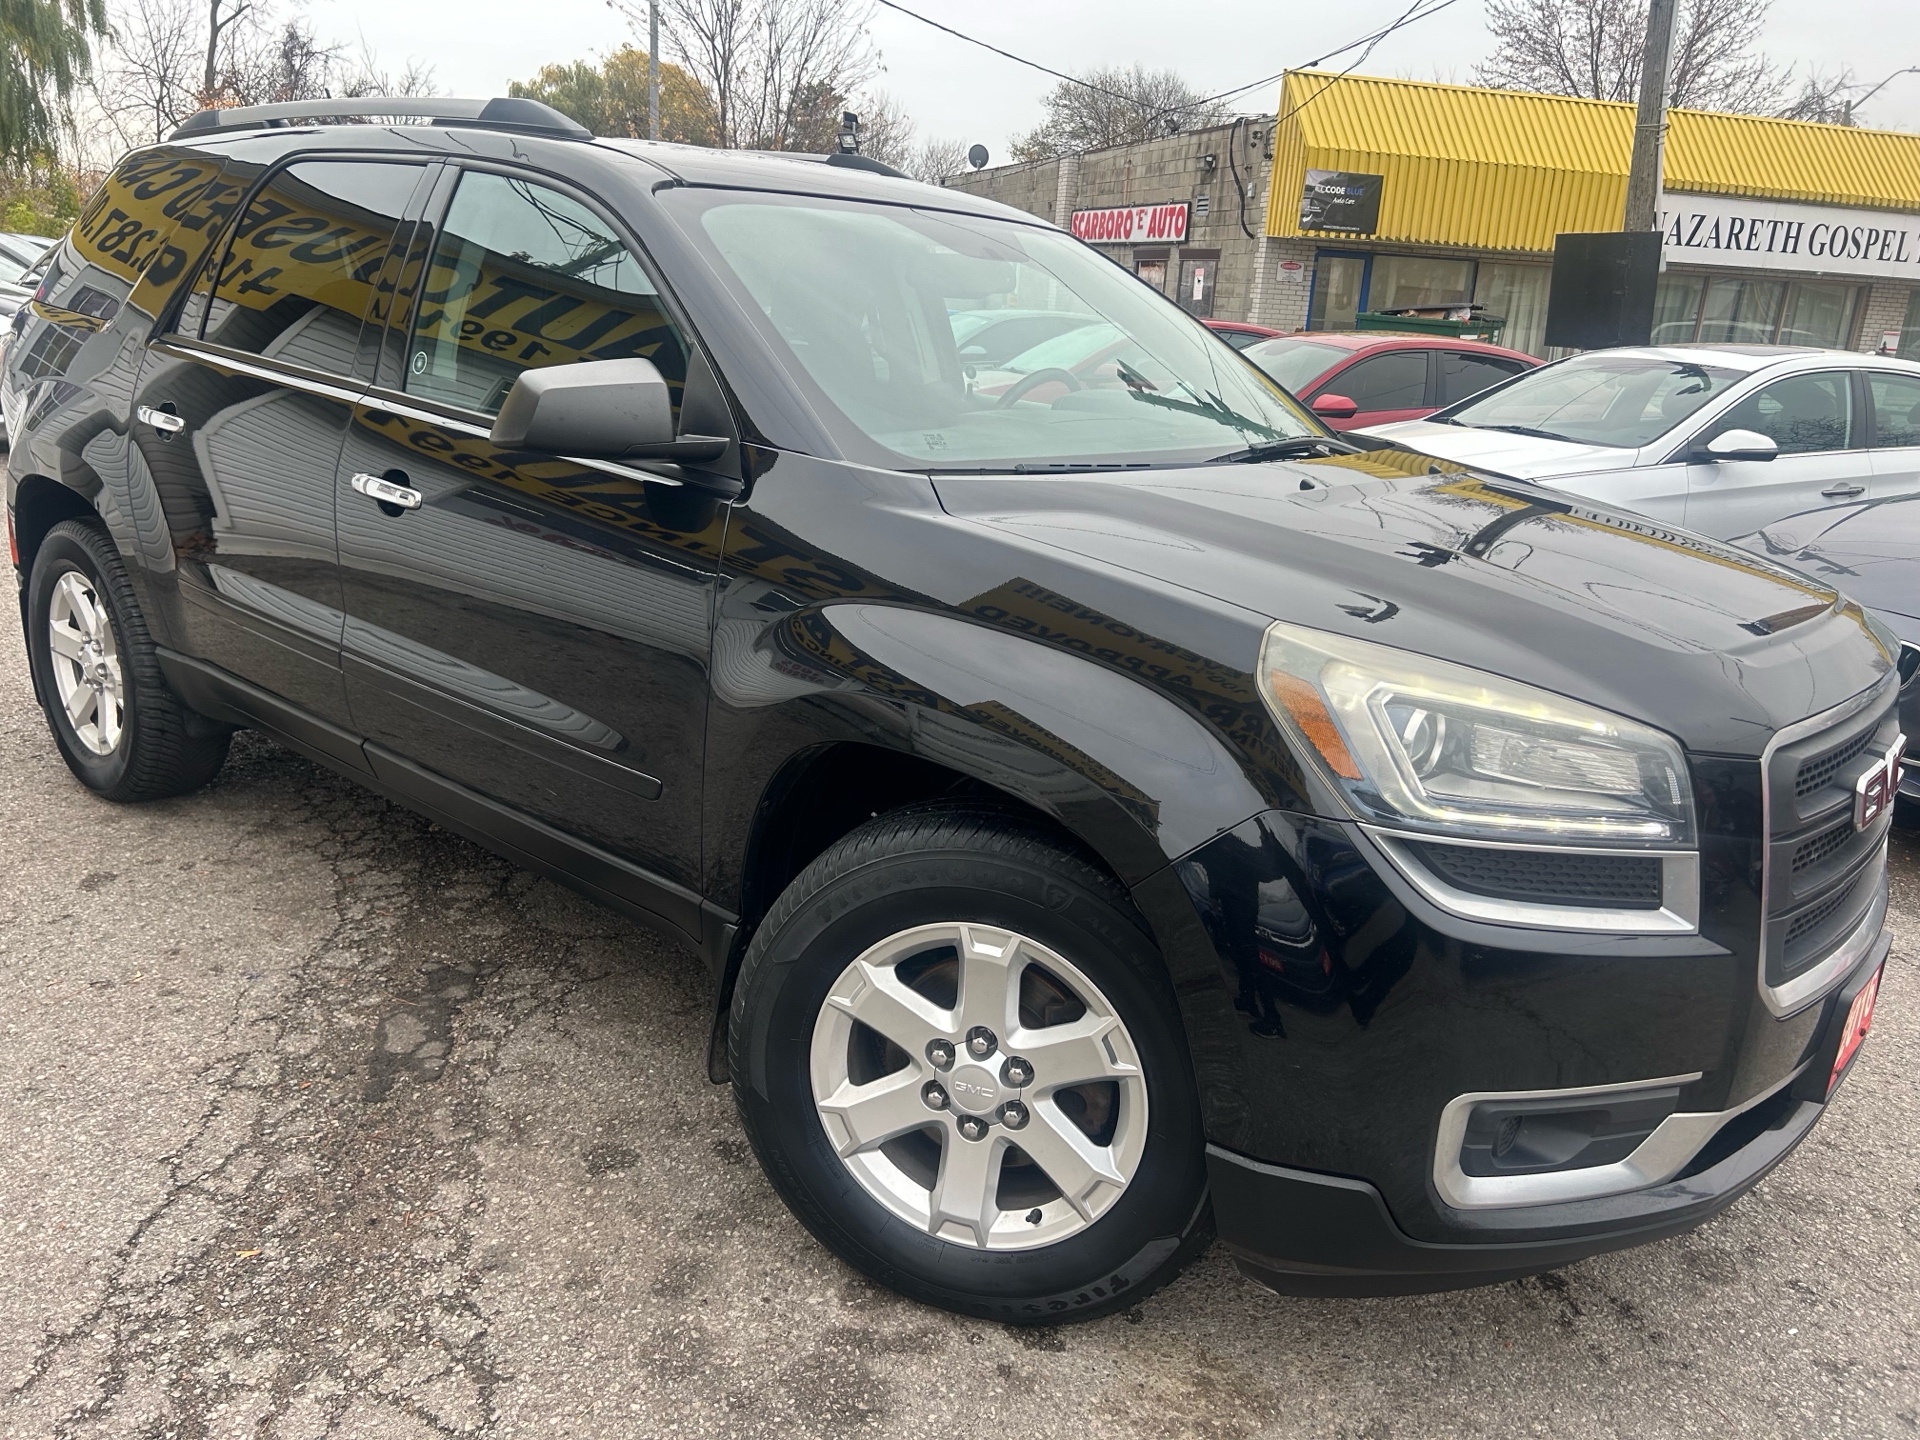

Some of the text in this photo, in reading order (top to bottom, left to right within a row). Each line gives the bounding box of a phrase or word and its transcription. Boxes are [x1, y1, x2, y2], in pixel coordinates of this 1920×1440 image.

[1325, 185, 1364, 196] CODE BLUE
[1332, 197, 1345, 205] Auto
[1071, 209, 1134, 241] SCARBORO
[1146, 205, 1186, 239] AUTO
[1807, 222, 1911, 263] GOSPEL
[953, 1080, 995, 1098] GMC
